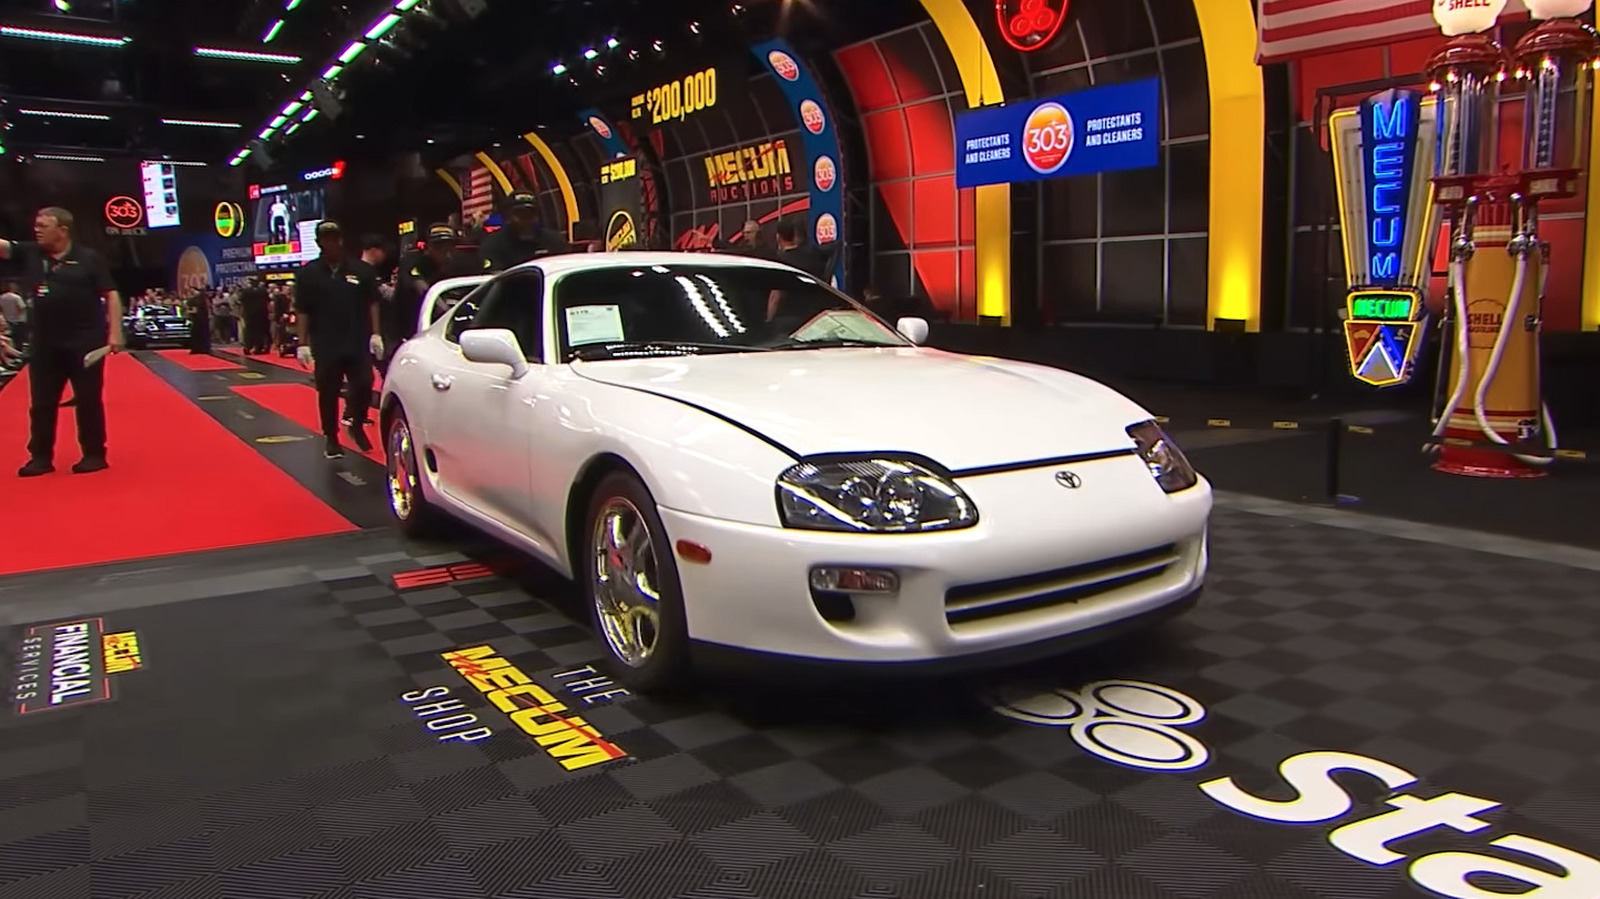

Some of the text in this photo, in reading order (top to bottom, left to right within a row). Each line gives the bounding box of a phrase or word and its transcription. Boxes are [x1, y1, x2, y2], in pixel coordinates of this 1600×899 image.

[1448, 0, 1491, 11] SHELL
[646, 67, 716, 124] $200,000
[1086, 112, 1142, 132] PROTECTANTS
[966, 133, 1010, 151] PROTECTANTS
[1028, 124, 1068, 153] 303
[1085, 127, 1143, 147] AND CLEANERS
[704, 139, 791, 188] MECUM
[965, 147, 1011, 164] AND CLEANERS
[710, 176, 793, 202] AUCTIONS
[1372, 98, 1406, 279] MECUM
[110, 204, 138, 218] 303
[1352, 298, 1411, 318] MECUM
[1467, 313, 1502, 325] SHELL
[51, 623, 92, 705] FINANCIAL
[102, 631, 142, 674] MECUM
[15, 636, 43, 700] SERVICES
[552, 664, 631, 704] THE
[400, 685, 493, 743] SHOP
[440, 644, 628, 772] MECUM
